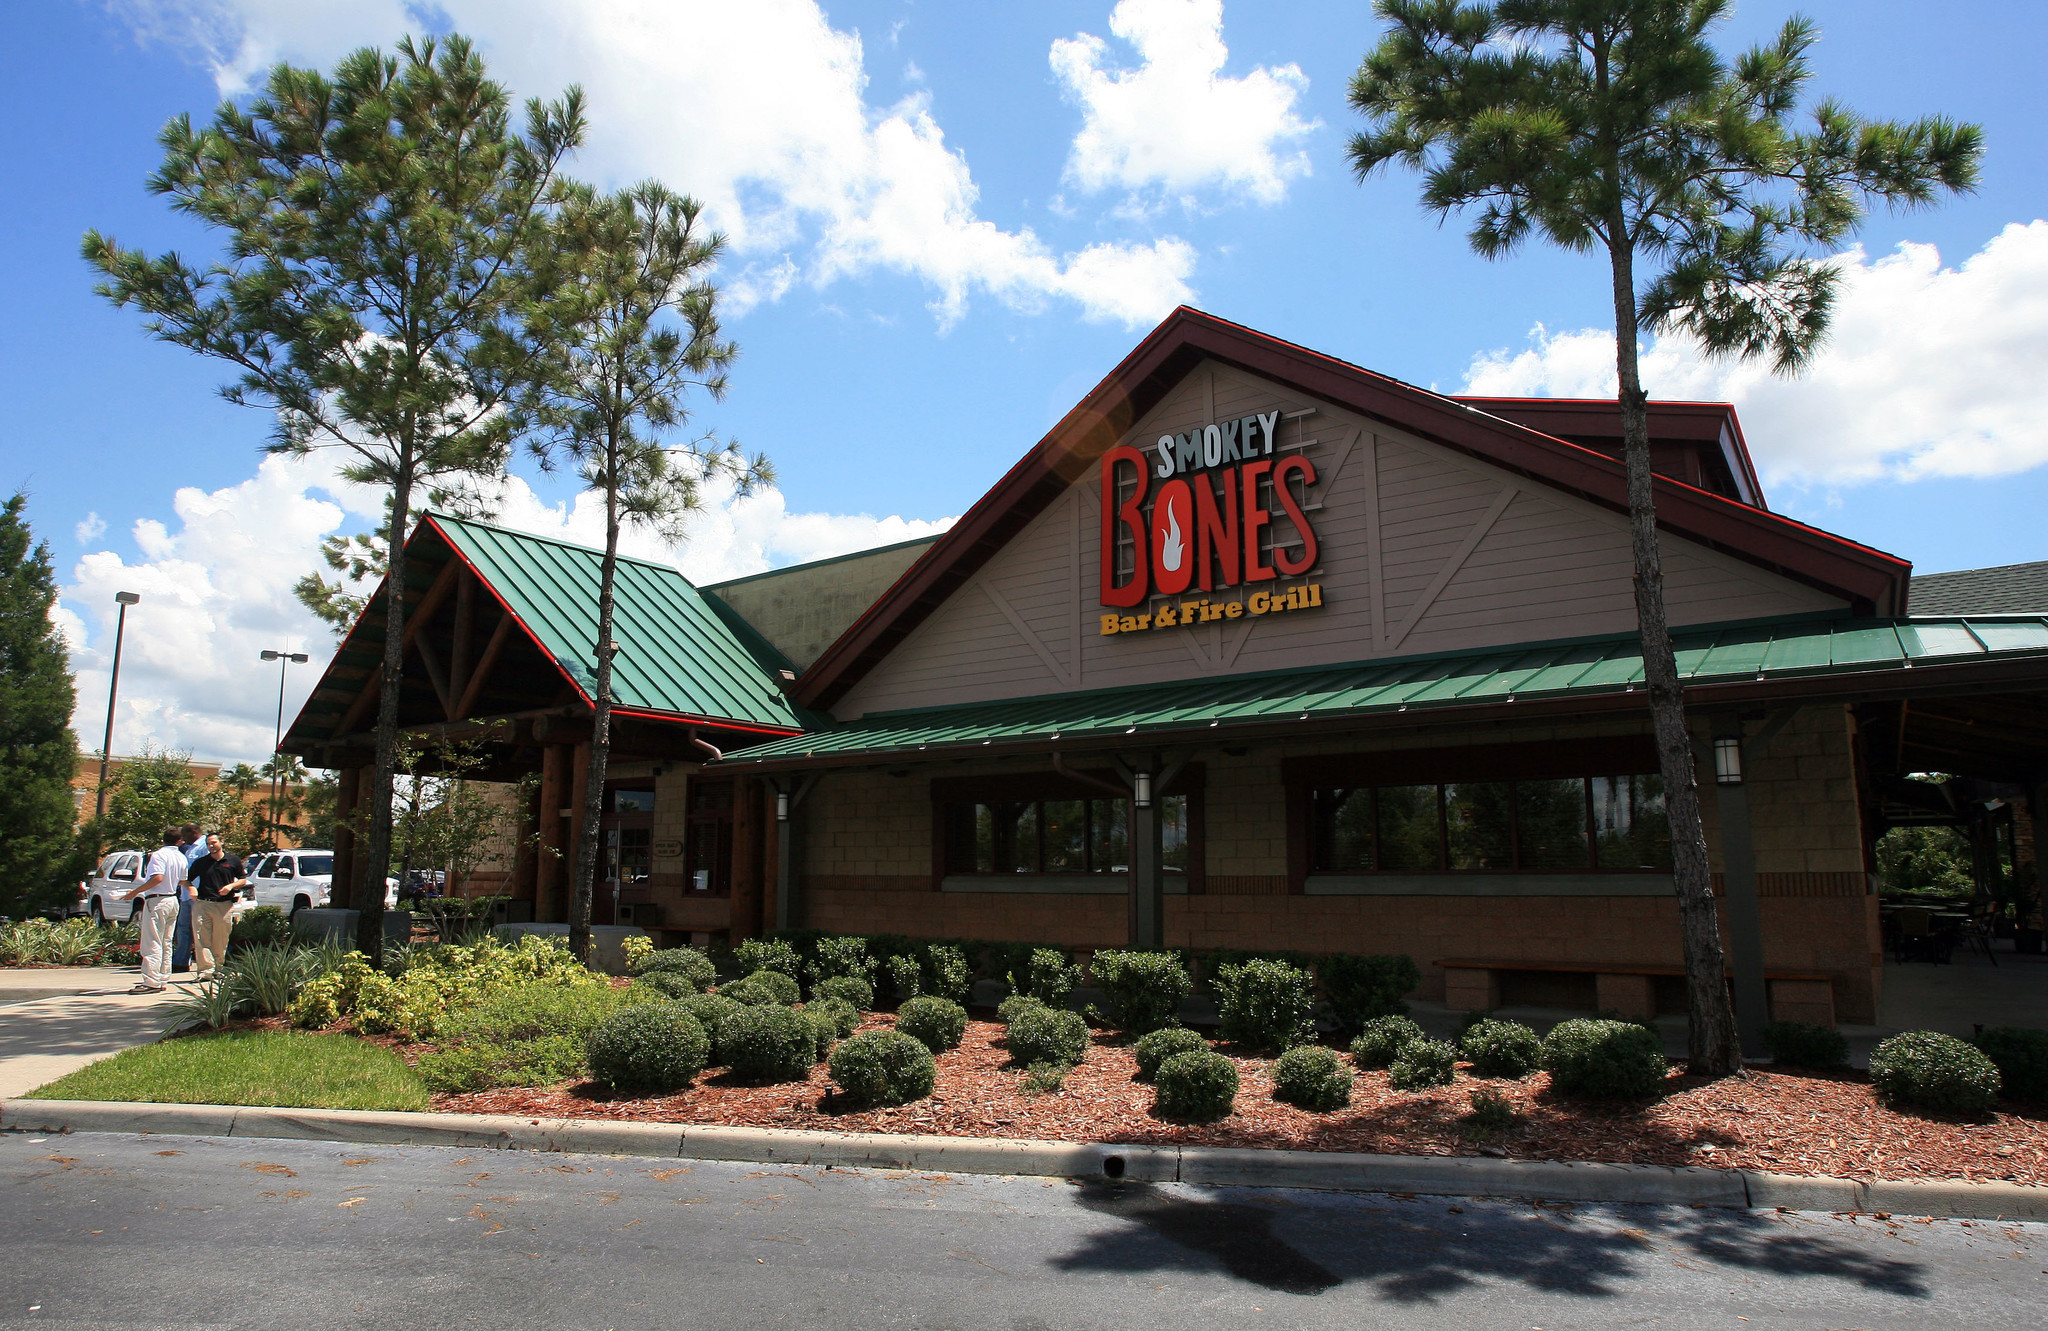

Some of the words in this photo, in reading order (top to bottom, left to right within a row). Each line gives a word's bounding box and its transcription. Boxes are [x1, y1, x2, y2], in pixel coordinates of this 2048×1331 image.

[1157, 410, 1280, 479] SMOKEY
[1100, 445, 1319, 608] BONES
[1100, 613, 1152, 636] Bar
[1154, 605, 1178, 628] &
[1179, 600, 1244, 625] Fire
[1248, 584, 1323, 615] Grill
